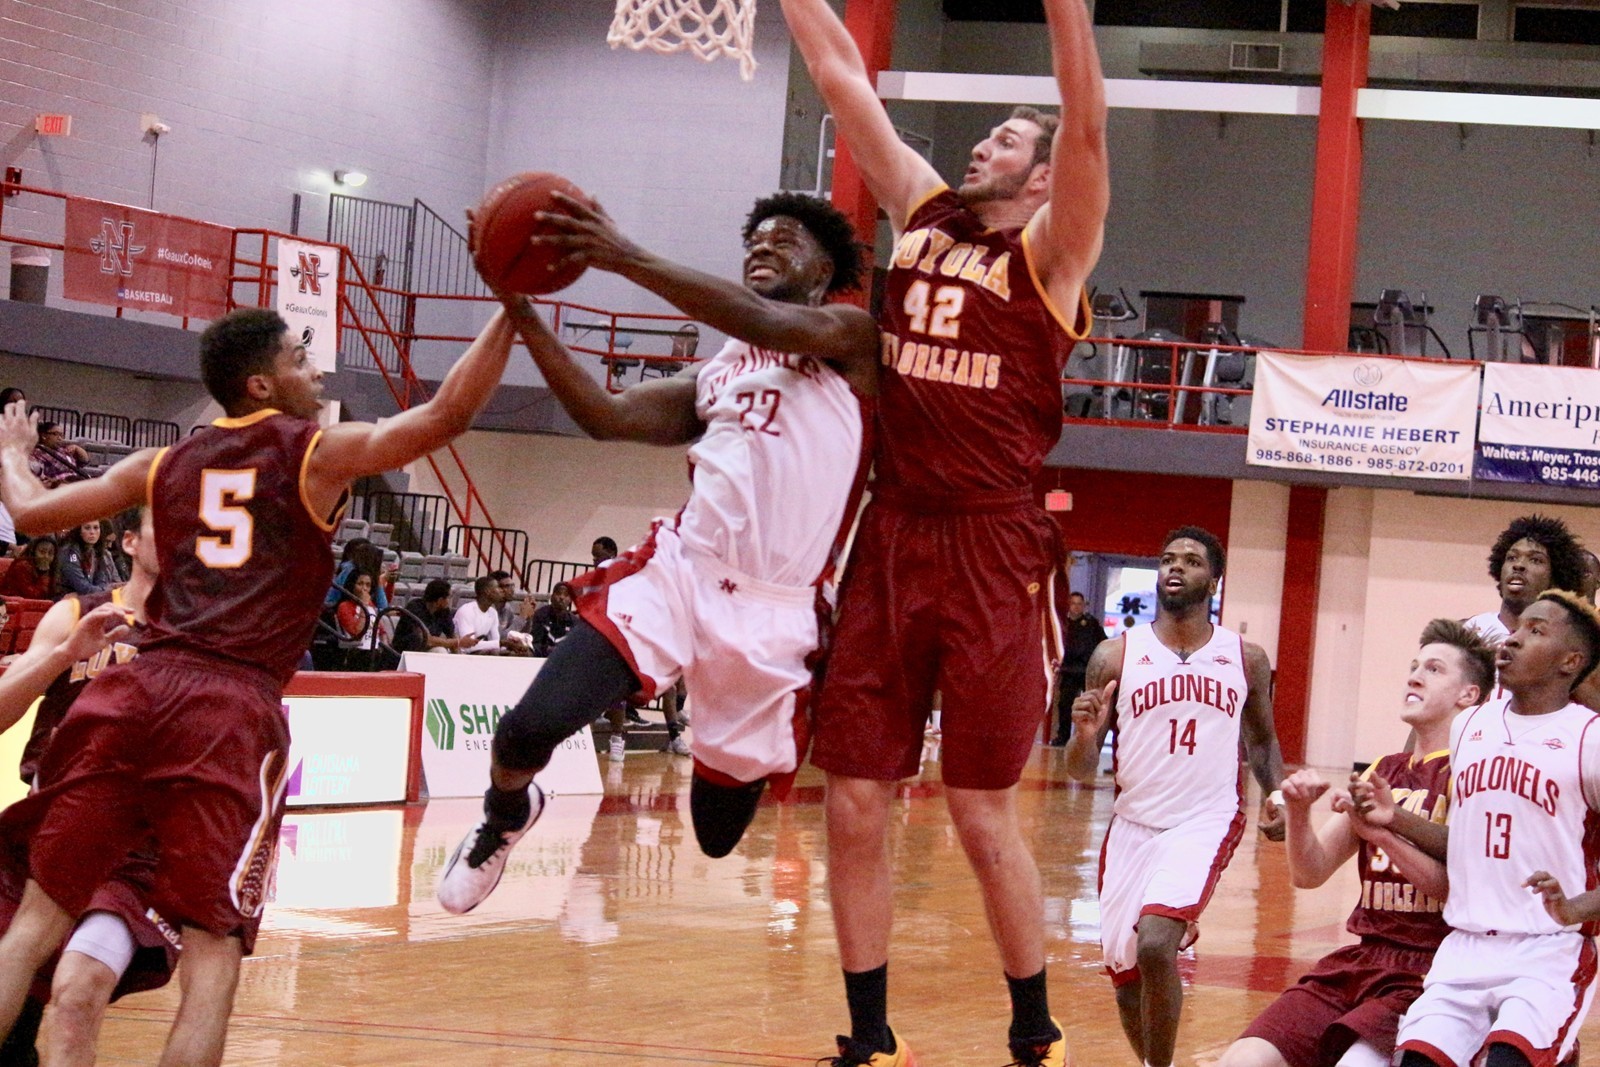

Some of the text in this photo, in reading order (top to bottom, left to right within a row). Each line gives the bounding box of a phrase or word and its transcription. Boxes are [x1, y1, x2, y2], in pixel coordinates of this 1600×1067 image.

[44, 116, 64, 134] EXIT
[903, 279, 965, 339] 42
[897, 341, 1001, 389] ORLEANS
[735, 389, 781, 437] 22
[1321, 388, 1408, 412] Allstate
[1265, 417, 1460, 444] STEPHANIE HEBERT
[1299, 439, 1421, 456] INSURANCE AGENCY
[1256, 449, 1464, 474] 985-868-1886 985-872-0201
[1481, 445, 1530, 462] Walters,
[1532, 450, 1572, 466] Meyer,
[195, 468, 257, 568] 5
[1131, 674, 1239, 719] COLONELS
[1169, 718, 1197, 756] 14
[1456, 755, 1560, 818] COLONELS
[1485, 811, 1512, 860] 13
